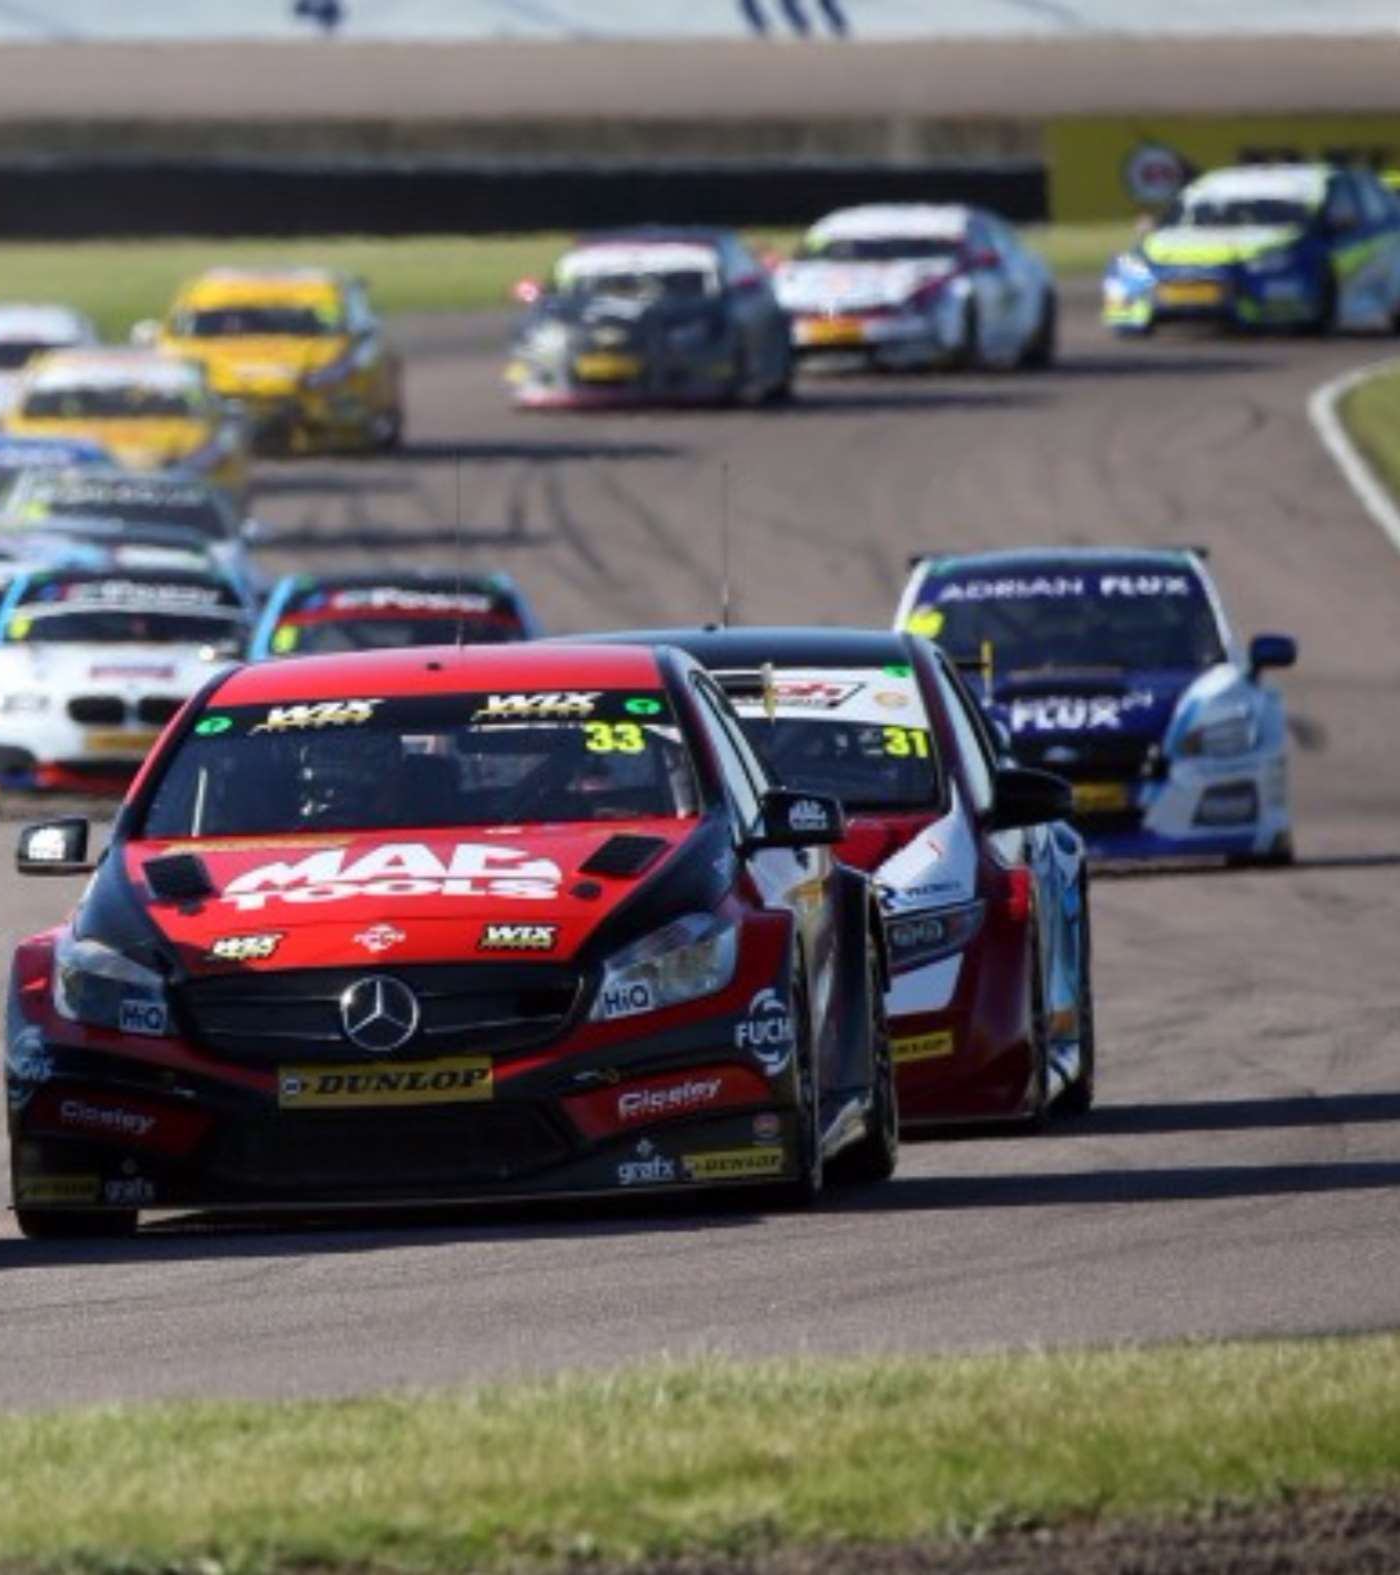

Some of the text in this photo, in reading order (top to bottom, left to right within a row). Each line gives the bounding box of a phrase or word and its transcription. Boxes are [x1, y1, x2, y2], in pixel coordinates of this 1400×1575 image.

[941, 575, 1189, 600] ADRIAN FLUX
[1011, 697, 1121, 732] FLUX
[585, 721, 646, 754] 33
[883, 726, 930, 758] 31
[220, 880, 559, 911] TOOLS
[603, 985, 649, 1015] HiQ
[121, 1003, 165, 1030] HiQ
[735, 1017, 795, 1048] FUCH
[315, 1067, 490, 1095] DUNLOP
